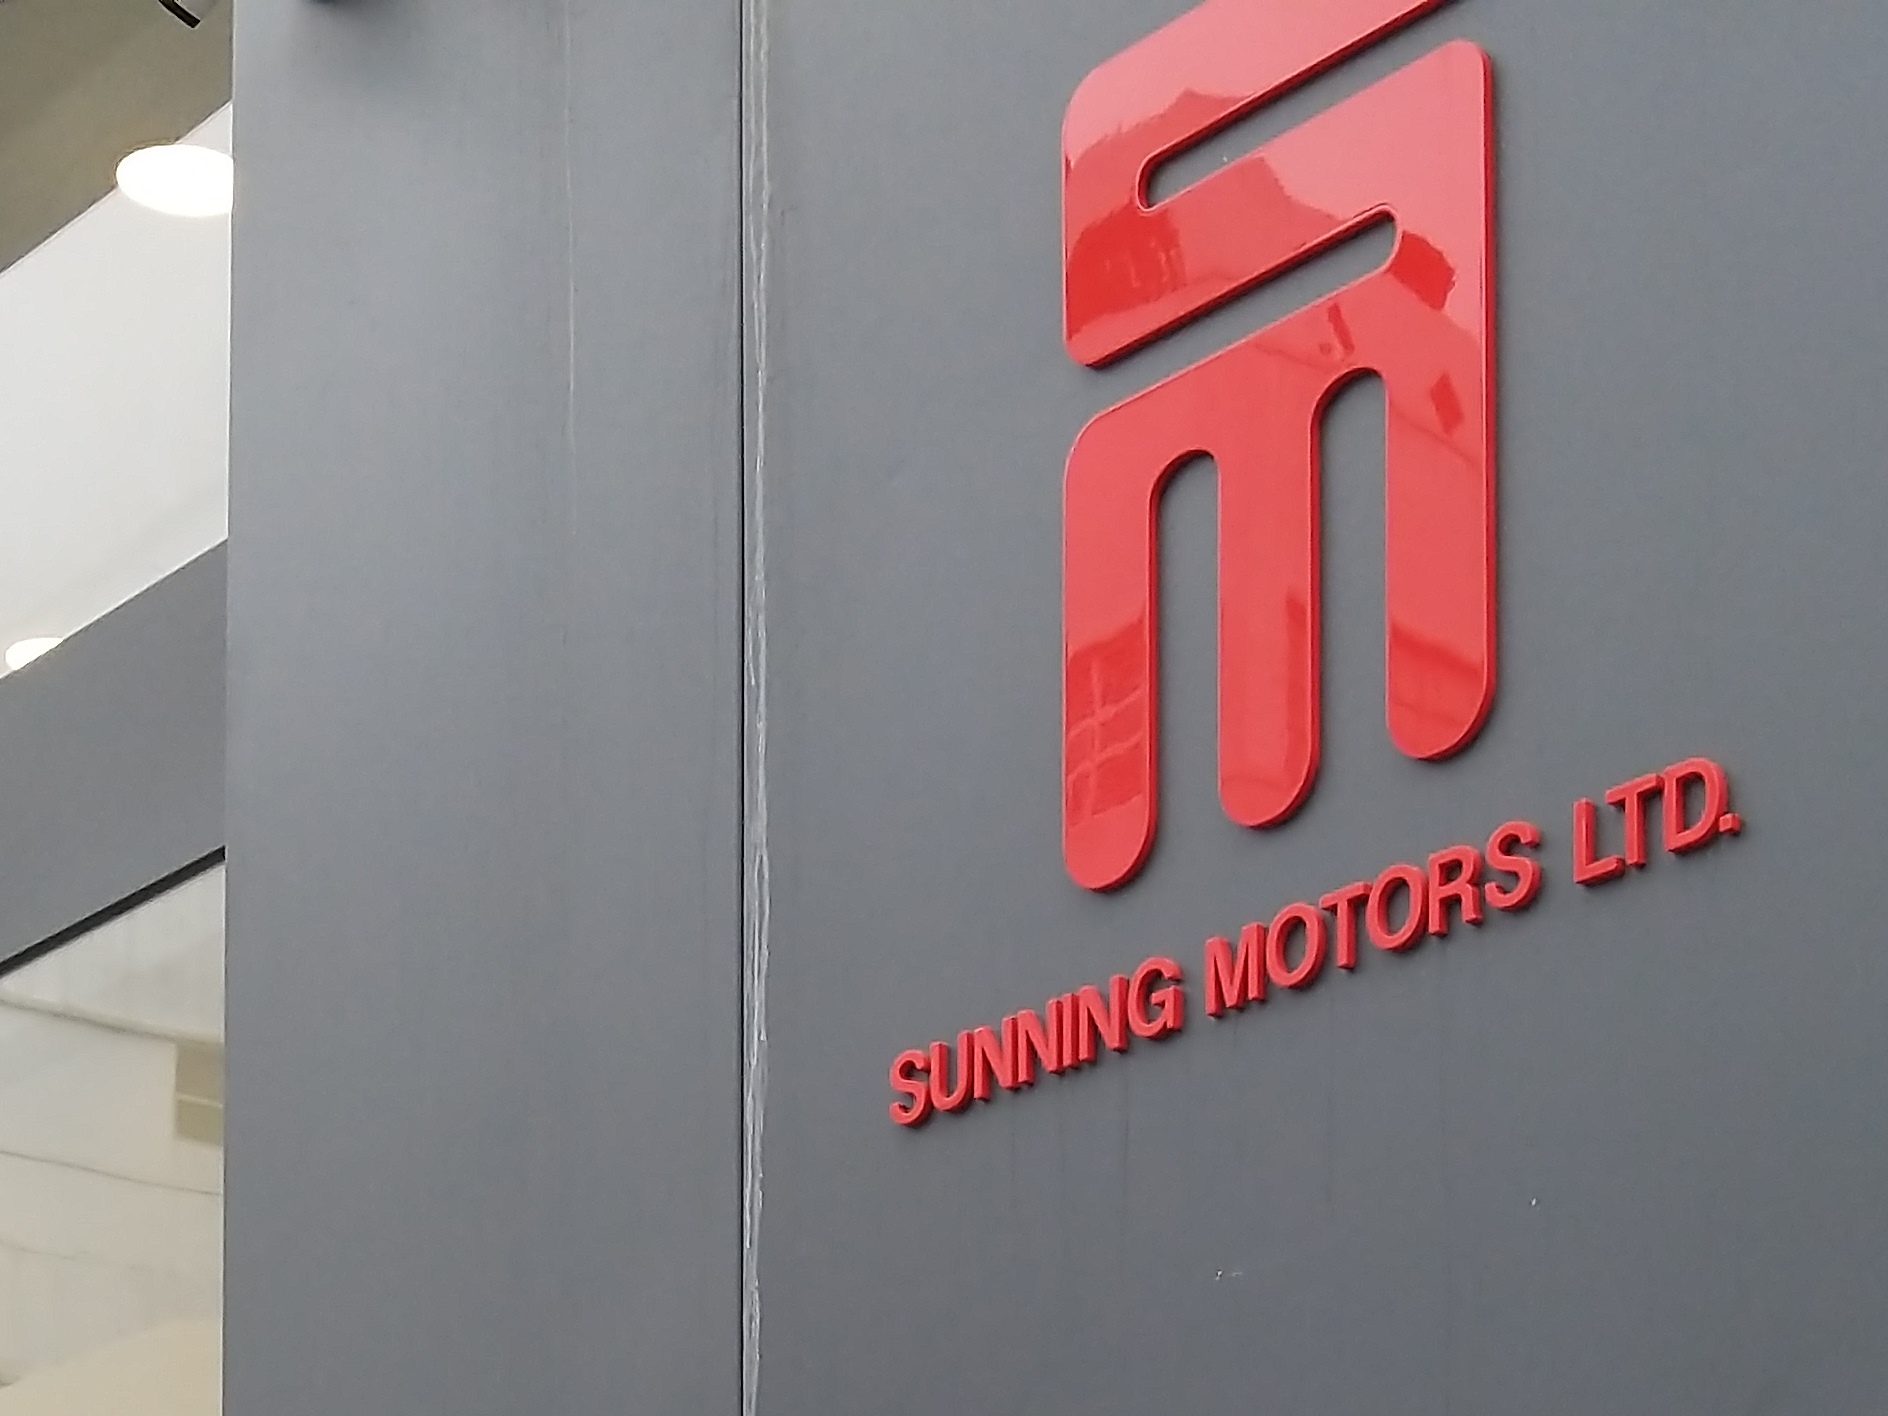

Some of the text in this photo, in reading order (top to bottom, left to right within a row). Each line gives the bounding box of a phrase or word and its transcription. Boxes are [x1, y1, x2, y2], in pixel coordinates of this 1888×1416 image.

[889, 757, 1742, 1127] SUNNING MOTORS LTD.
